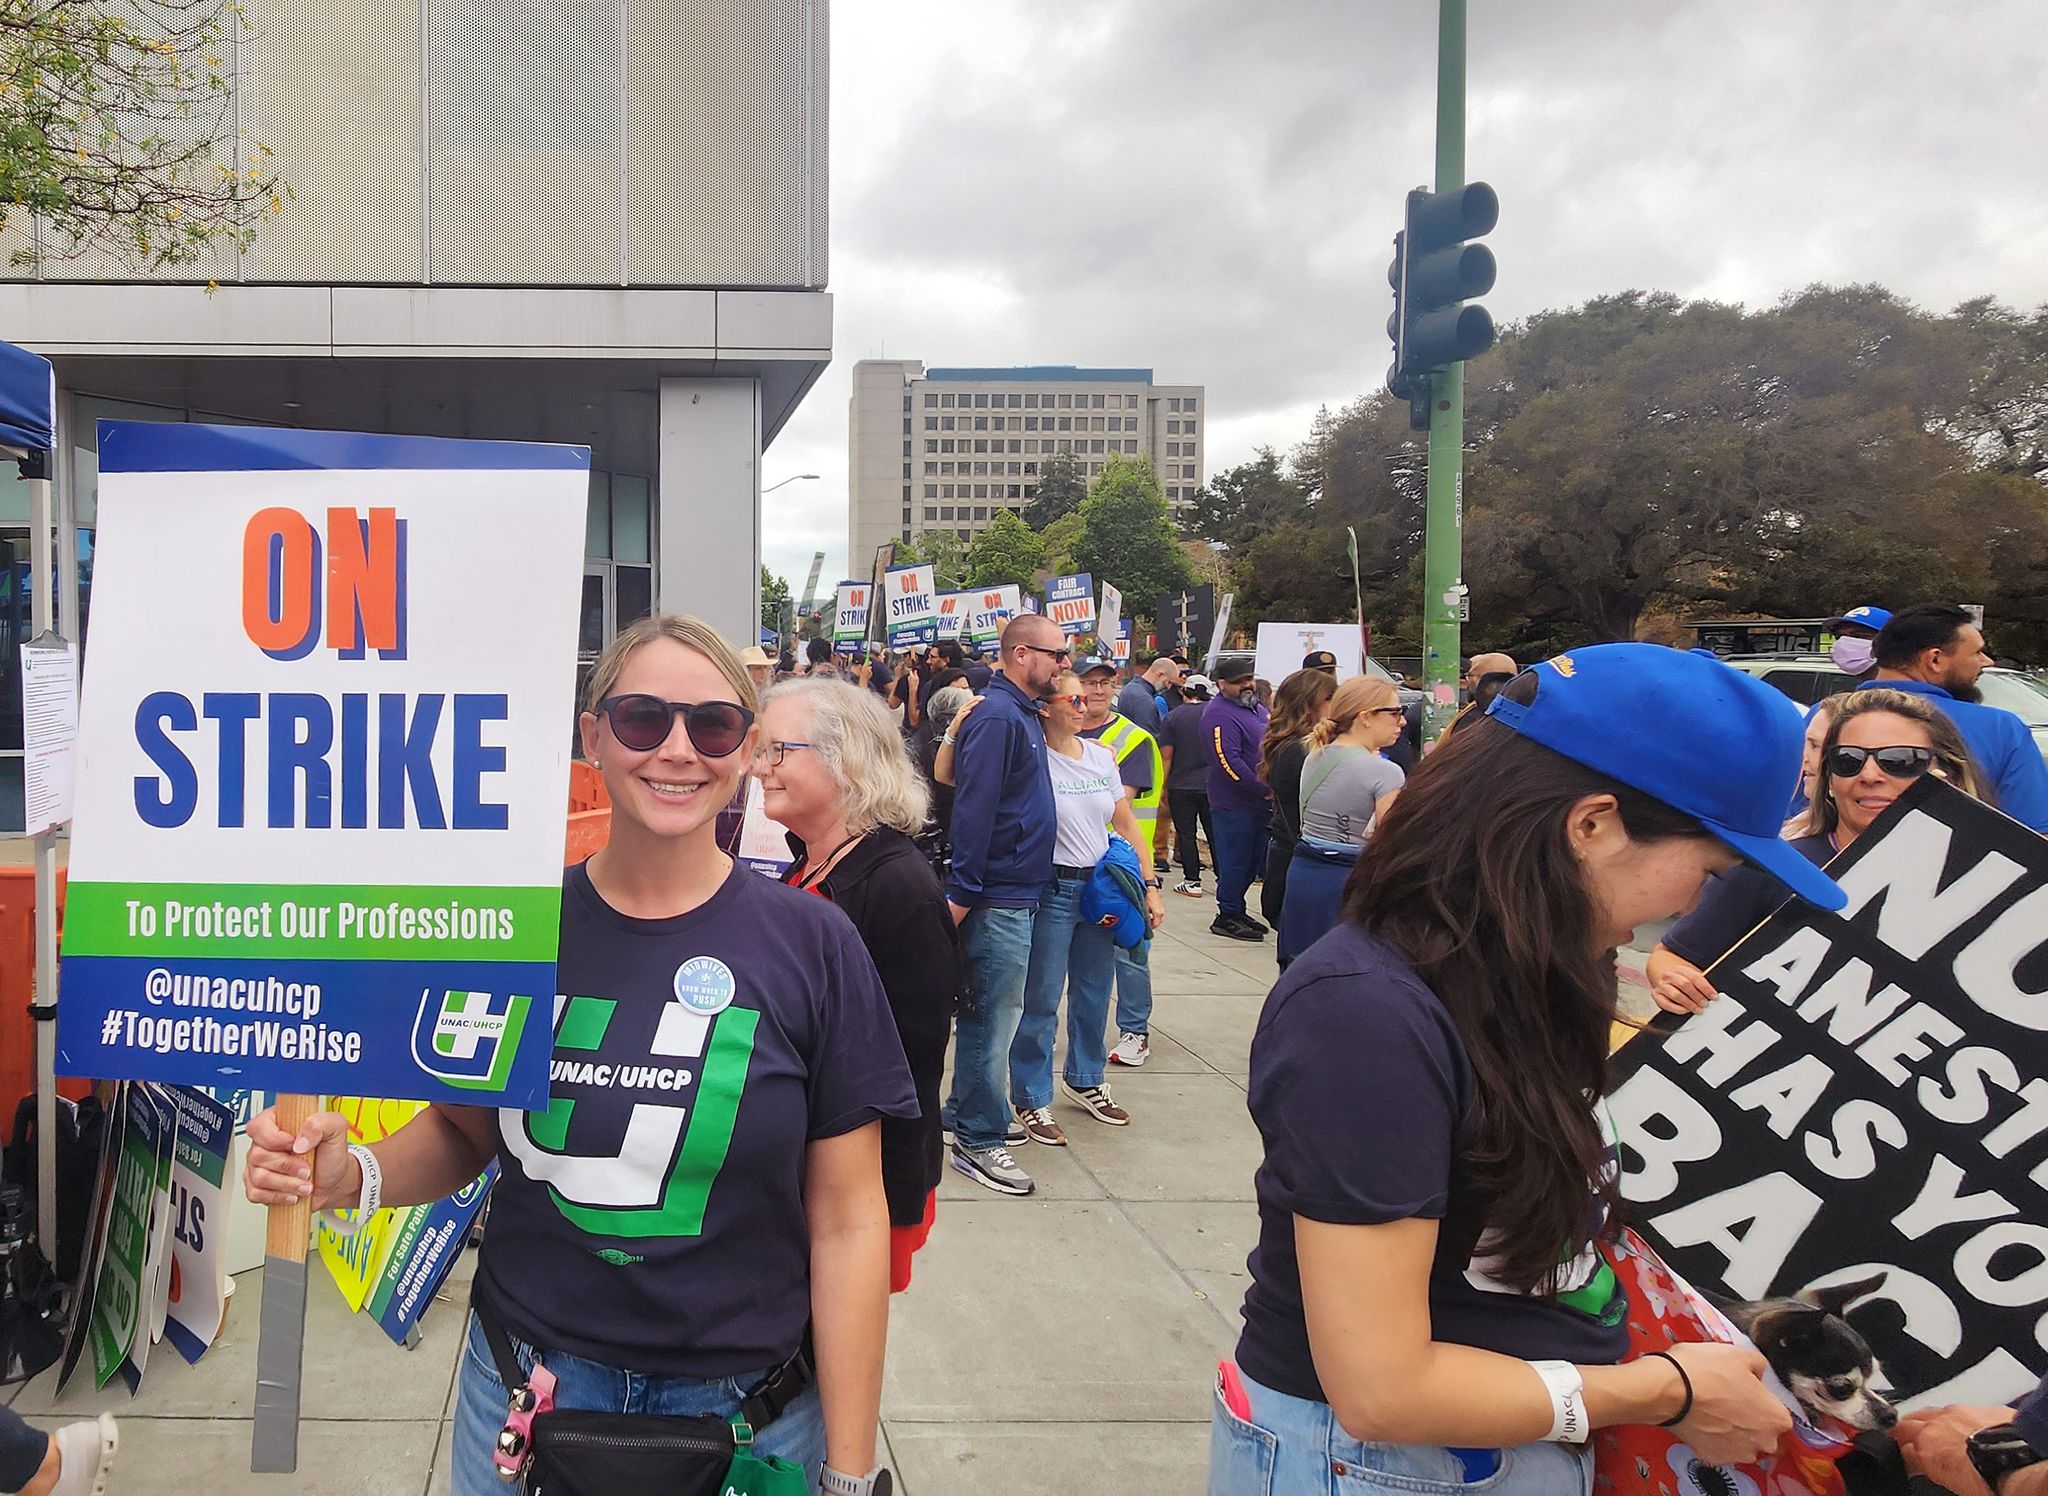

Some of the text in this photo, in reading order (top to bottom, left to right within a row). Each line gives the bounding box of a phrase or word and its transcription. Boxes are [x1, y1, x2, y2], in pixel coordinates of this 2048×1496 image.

[242, 506, 407, 661] ON
[900, 573, 918, 594] ON
[1052, 587, 1086, 599] CONTRACT
[1058, 577, 1077, 590] FAIR
[850, 590, 864, 607] ON
[892, 593, 930, 616] STRIKE
[940, 598, 956, 615] ON
[983, 592, 1002, 610] ON
[841, 610, 866, 626] STRIK
[976, 608, 1015, 628] STRE
[1053, 599, 1089, 623] NOW
[937, 616, 960, 632] RIKE
[134, 691, 509, 830] STRIKE
[1058, 777, 1111, 790] ALLIANC
[126, 900, 514, 941] To Protect Our Professions
[683, 960, 728, 980] MIDWIVES
[145, 968, 321, 1018] @unacuhcp
[693, 994, 716, 1006] PUSH
[440, 1018, 503, 1030] UNAC/UHCP
[100, 1009, 362, 1064] #TogetherWeRise
[1740, 926, 2048, 1190] ANEST
[550, 1060, 692, 1091] UNAC/UHCP
[1661, 993, 1908, 1180] HAS
[387, 1203, 429, 1281] For Safe Patie
[396, 1226, 436, 1296] @unacuhcp
[1890, 1153, 2048, 1357] YO
[396, 1219, 457, 1323] #TogetherWeRise
